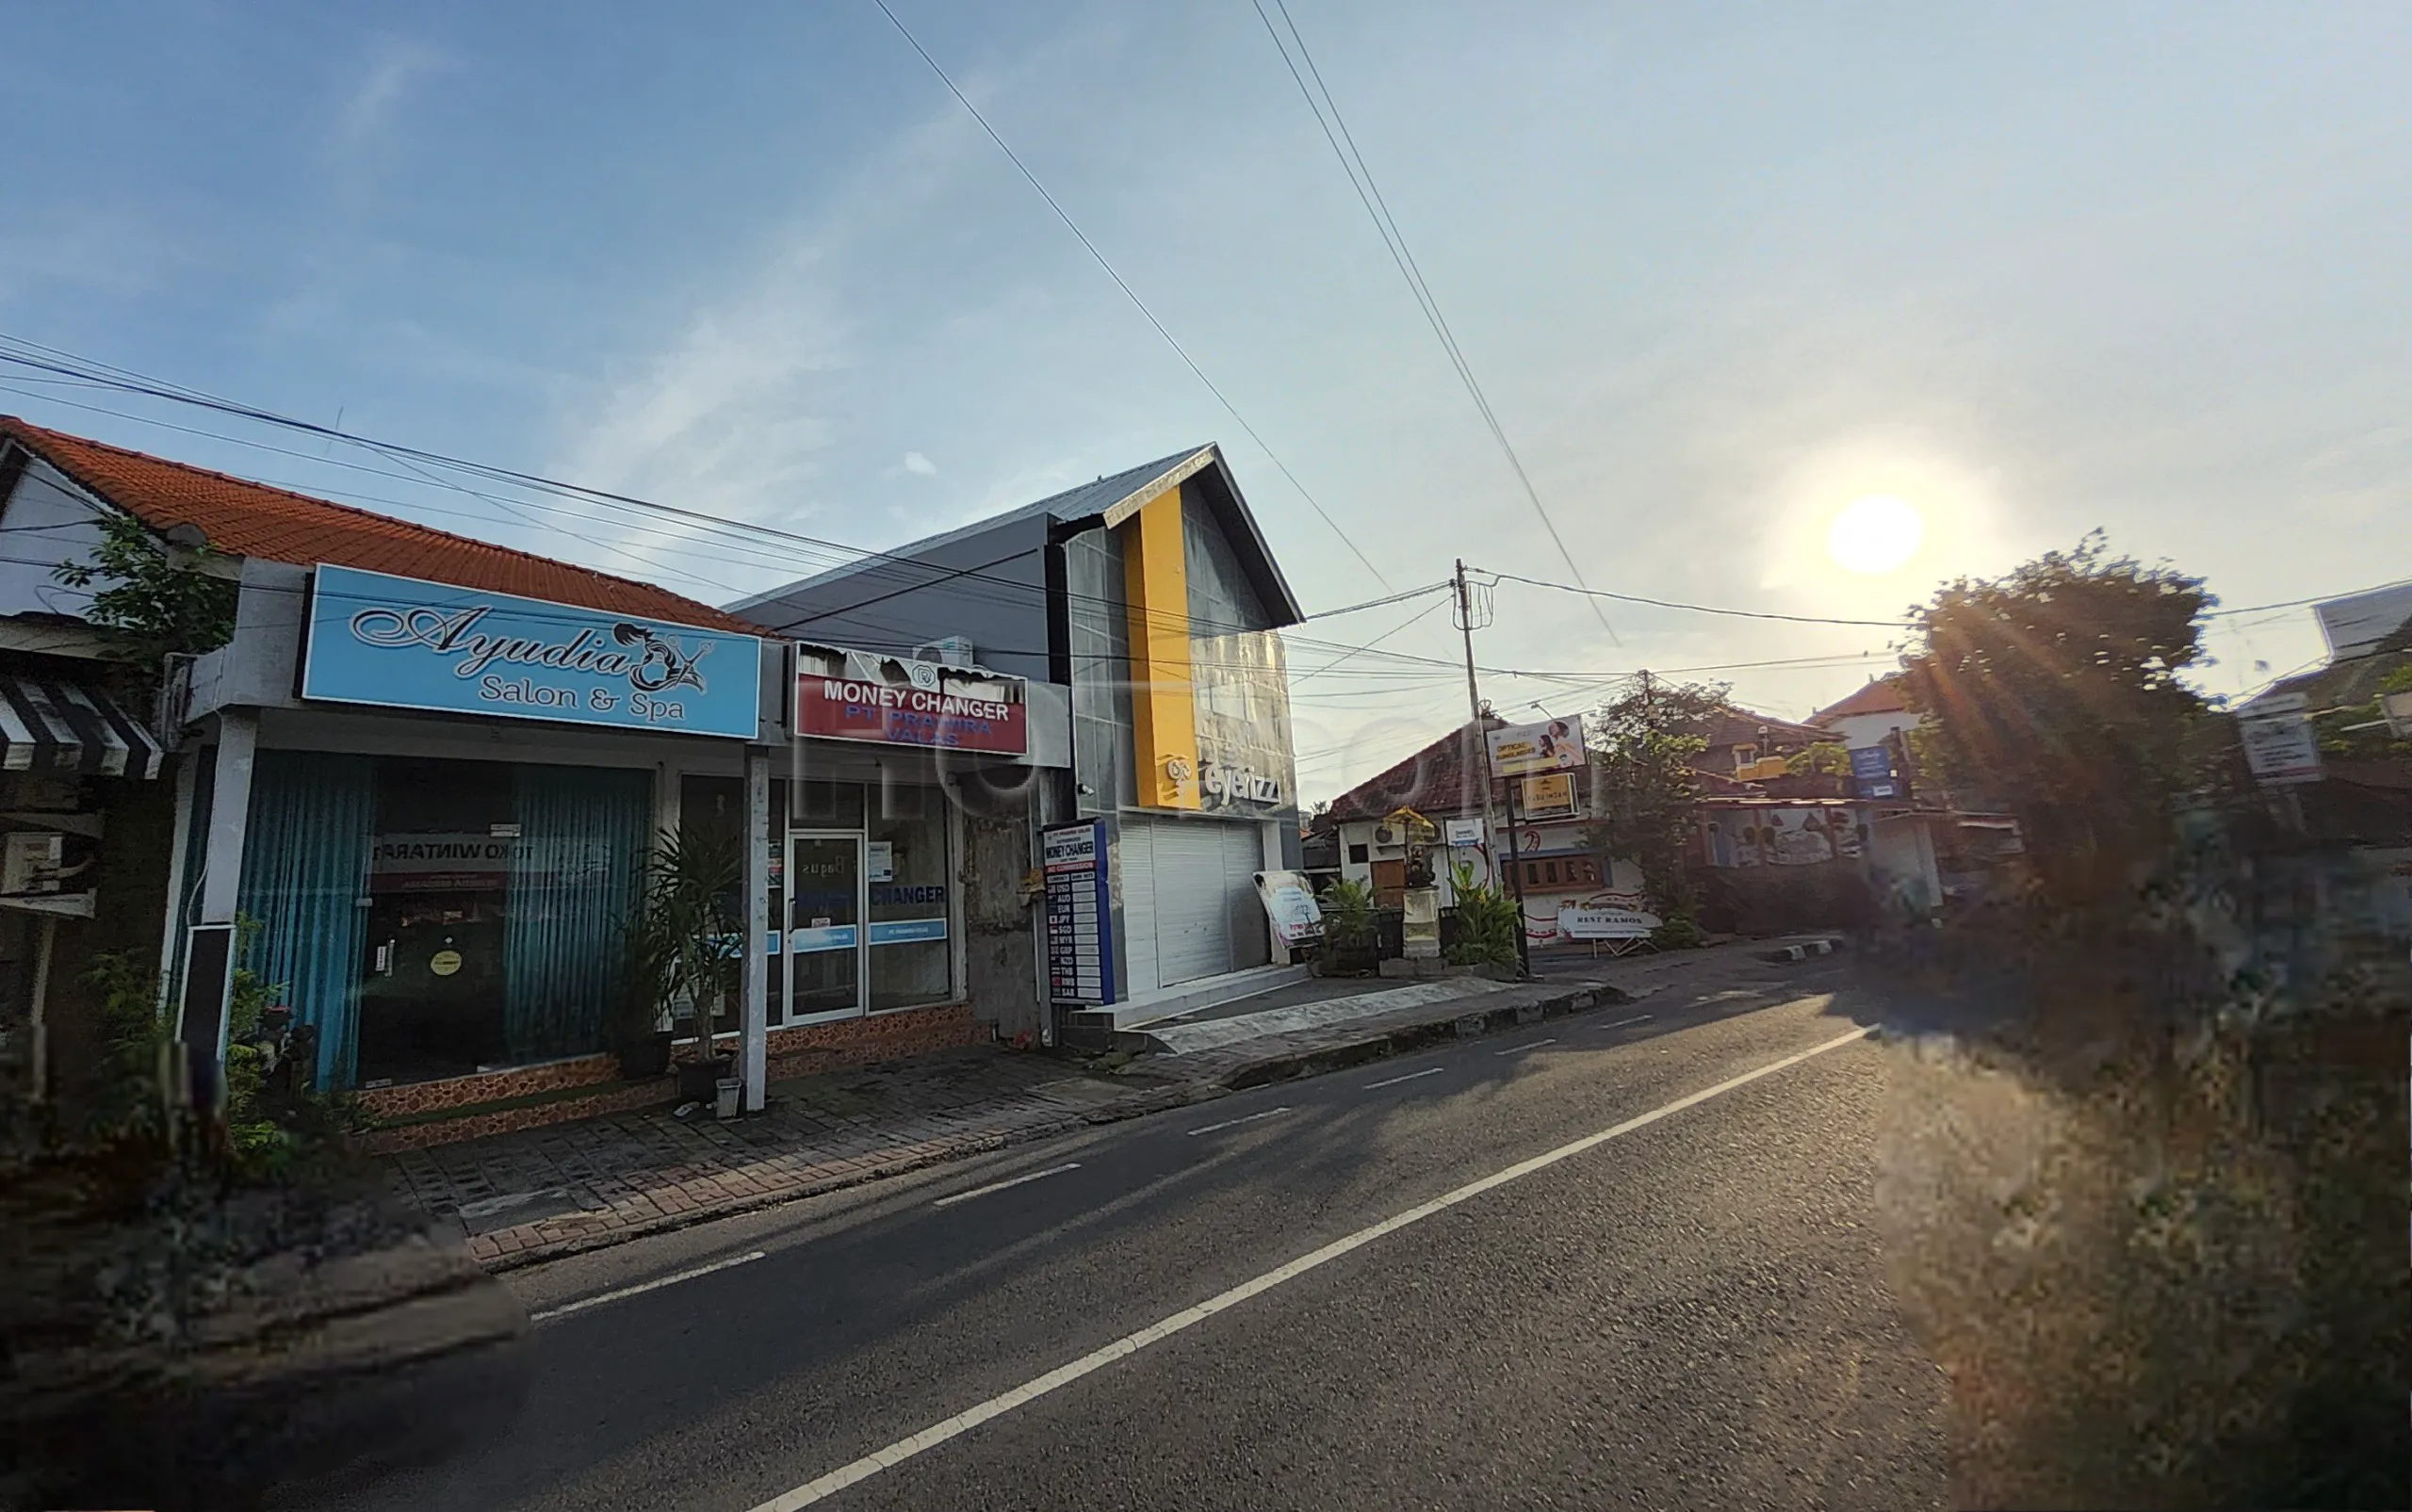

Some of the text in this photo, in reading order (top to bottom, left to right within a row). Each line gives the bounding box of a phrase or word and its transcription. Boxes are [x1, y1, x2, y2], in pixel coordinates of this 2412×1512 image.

[351, 605, 630, 677] Ayudia
[480, 676, 685, 723] Salon & Spa
[824, 679, 1010, 722] MONEY CHANGER
[845, 706, 874, 721] PT
[886, 728, 958, 746] VALAS
